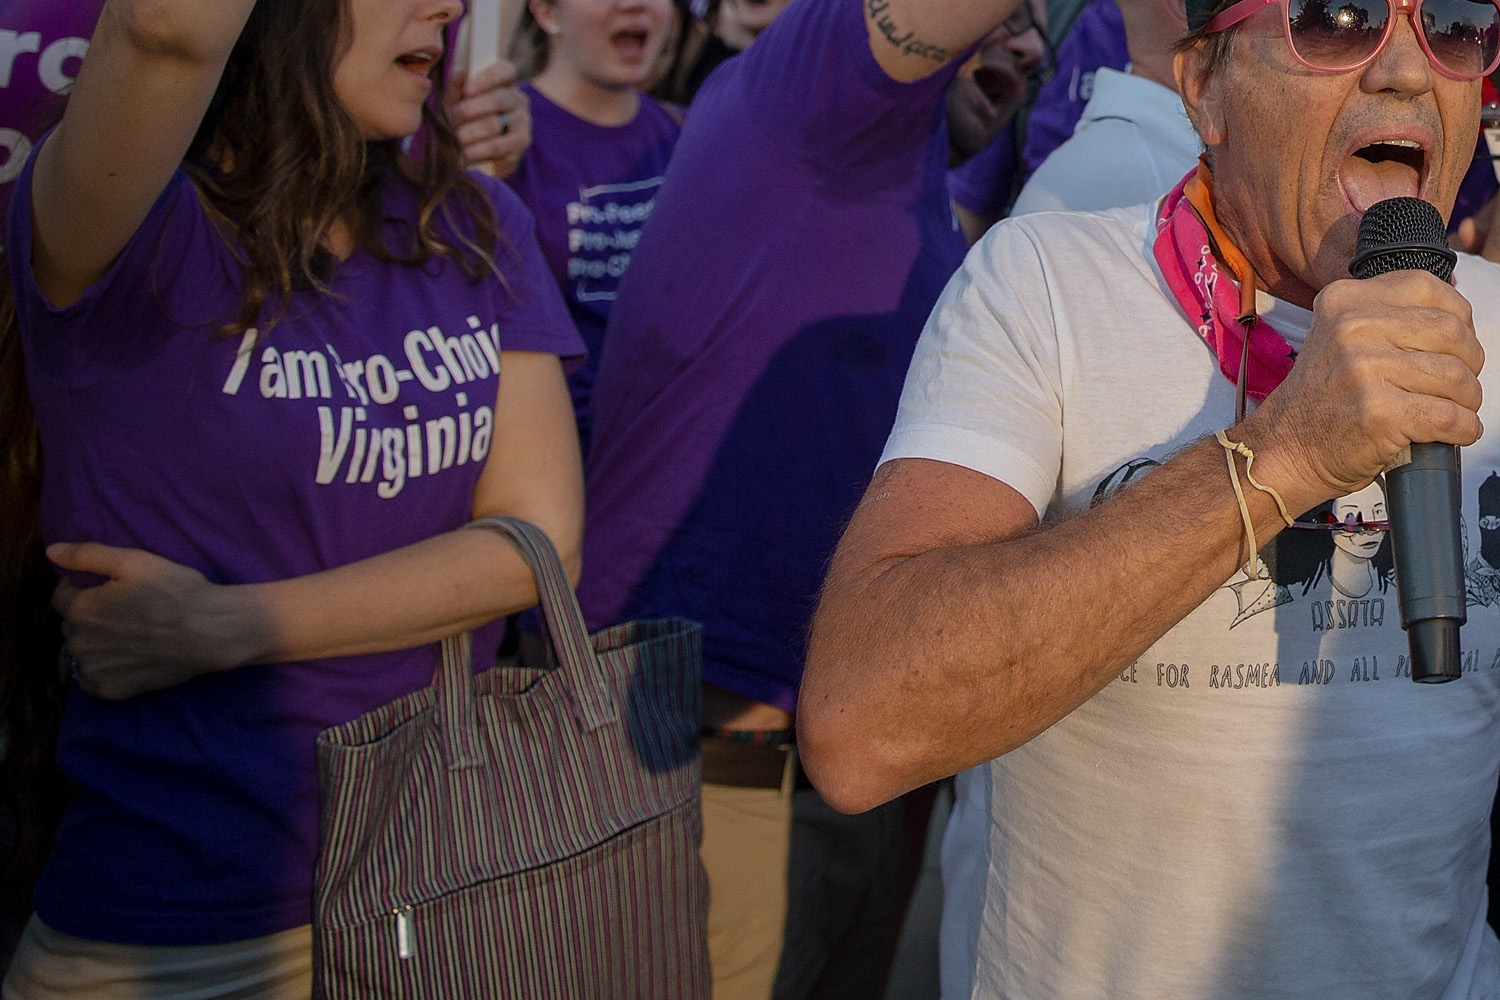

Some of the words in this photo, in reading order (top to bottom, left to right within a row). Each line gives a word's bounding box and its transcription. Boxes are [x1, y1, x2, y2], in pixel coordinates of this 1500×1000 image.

[222, 327, 258, 395] I
[259, 346, 333, 399] am
[1156, 663, 1190, 688] FOR
[1209, 663, 1281, 689] RASMEA
[1298, 659, 1336, 685] AND
[1350, 656, 1380, 682] ALL
